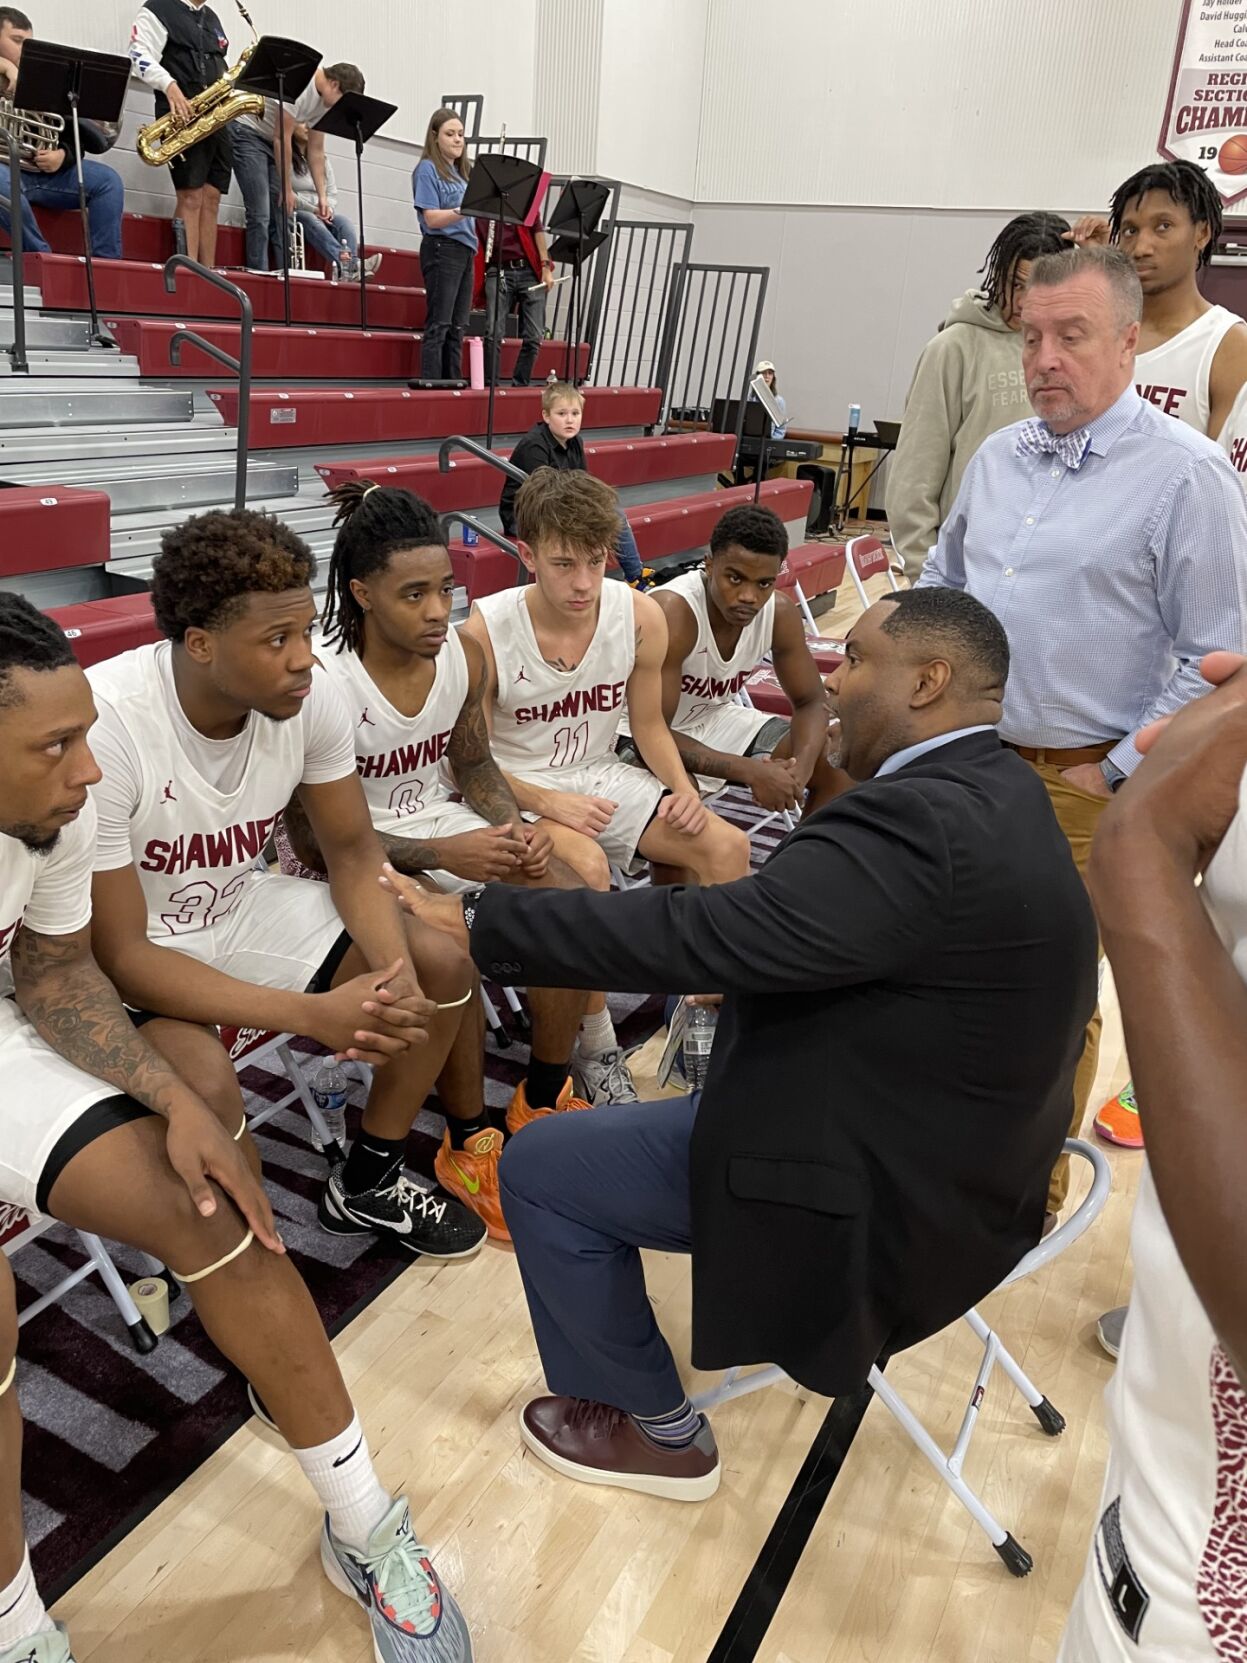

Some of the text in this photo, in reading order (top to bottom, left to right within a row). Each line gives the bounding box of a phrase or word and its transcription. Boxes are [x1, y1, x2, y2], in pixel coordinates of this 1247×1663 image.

[1200, 11, 1222, 21] David
[1214, 38, 1234, 48] Head
[1199, 52, 1234, 62] Assistant
[1198, 146, 1218, 160] 19
[514, 681, 625, 726] SHAWNEE
[549, 720, 589, 768] 11
